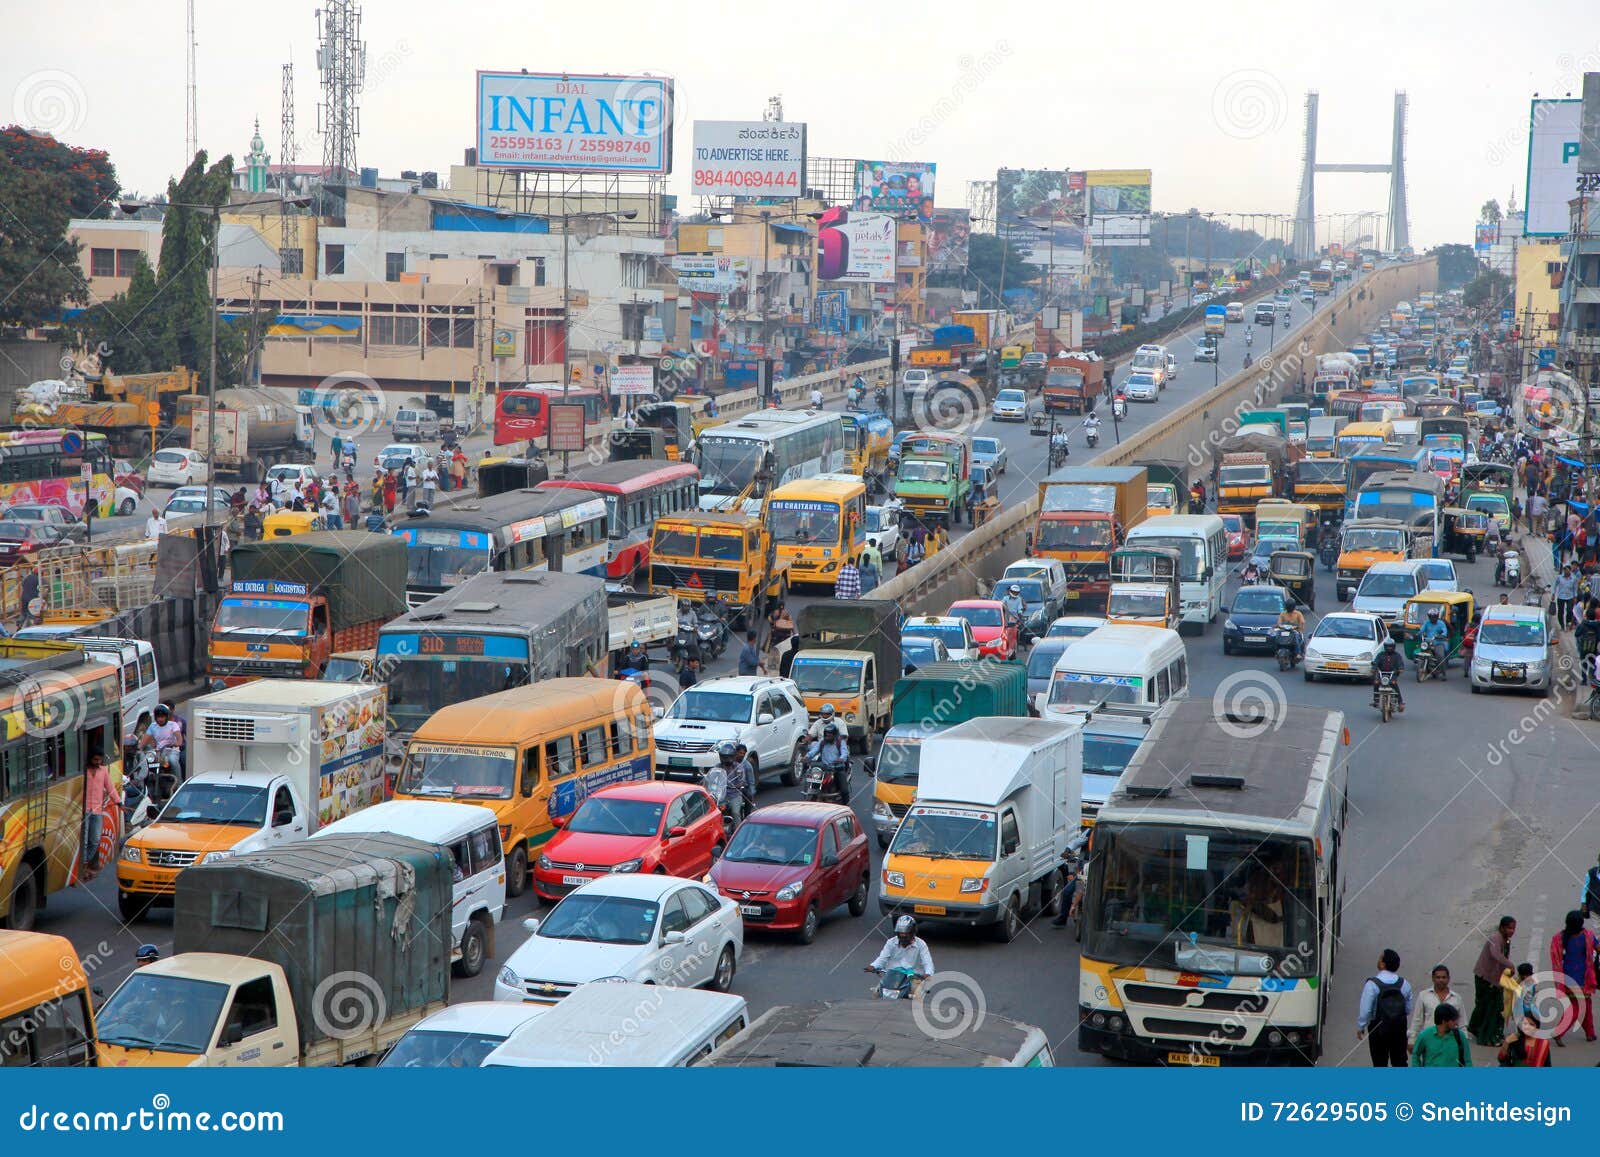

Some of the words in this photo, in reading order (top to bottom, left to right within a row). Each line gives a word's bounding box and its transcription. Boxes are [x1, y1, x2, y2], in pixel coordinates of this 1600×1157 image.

[556, 83, 588, 94] DIAL
[488, 95, 655, 136] INFANT
[490, 136, 562, 150] 25595163
[567, 141, 574, 152] /
[579, 139, 651, 153] 25598740
[494, 151, 520, 160] Email:
[697, 147, 708, 161] TO
[710, 148, 763, 161] ADVERTISE
[765, 149, 802, 162] HERE...
[694, 170, 798, 188] 9844069444
[855, 231, 882, 243] petals
[772, 502, 783, 510] SRI
[784, 502, 822, 511] CHAITANYA
[421, 637, 443, 652] 310
[346, 1049, 369, 1060] STATE
